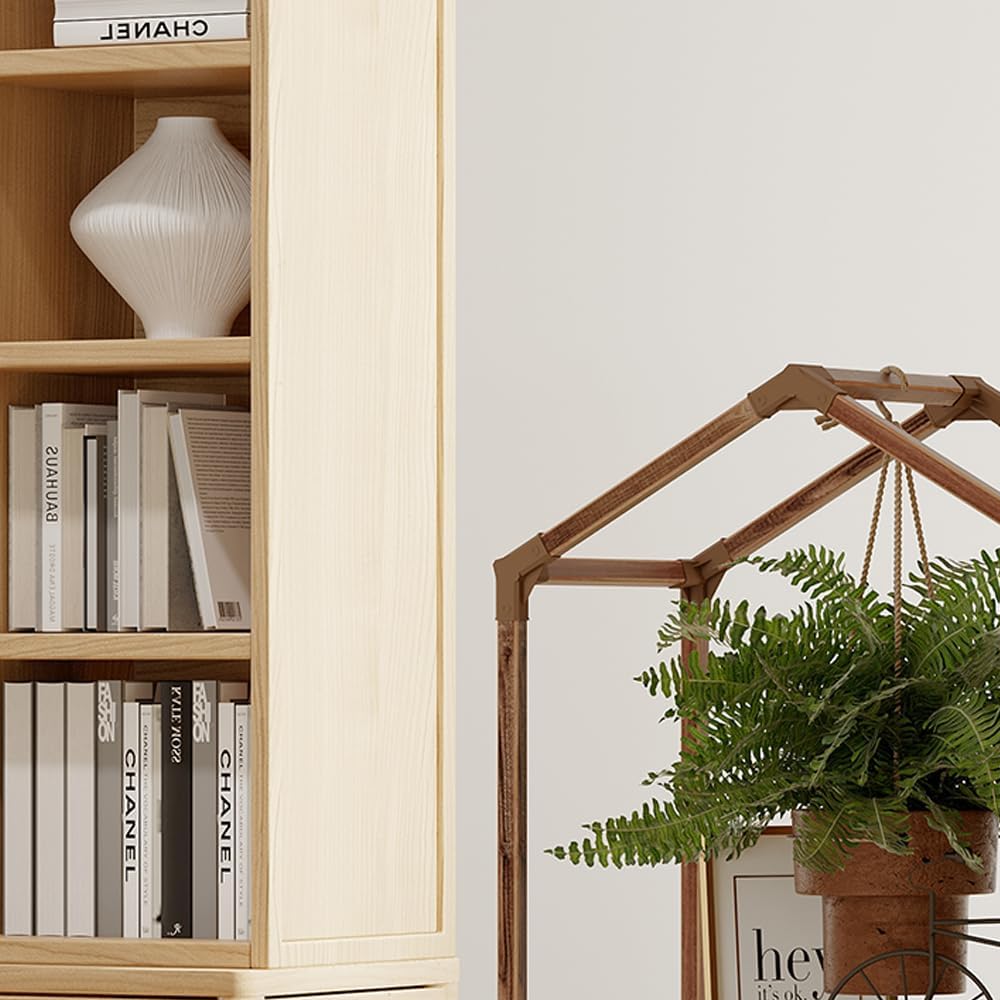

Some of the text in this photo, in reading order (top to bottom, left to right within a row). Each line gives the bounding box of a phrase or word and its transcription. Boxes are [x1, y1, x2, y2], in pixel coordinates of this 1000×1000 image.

[125, 749, 136, 882] CHANEL
[220, 749, 232, 884] CHANEL
[784, 984, 807, 1000] ok.
